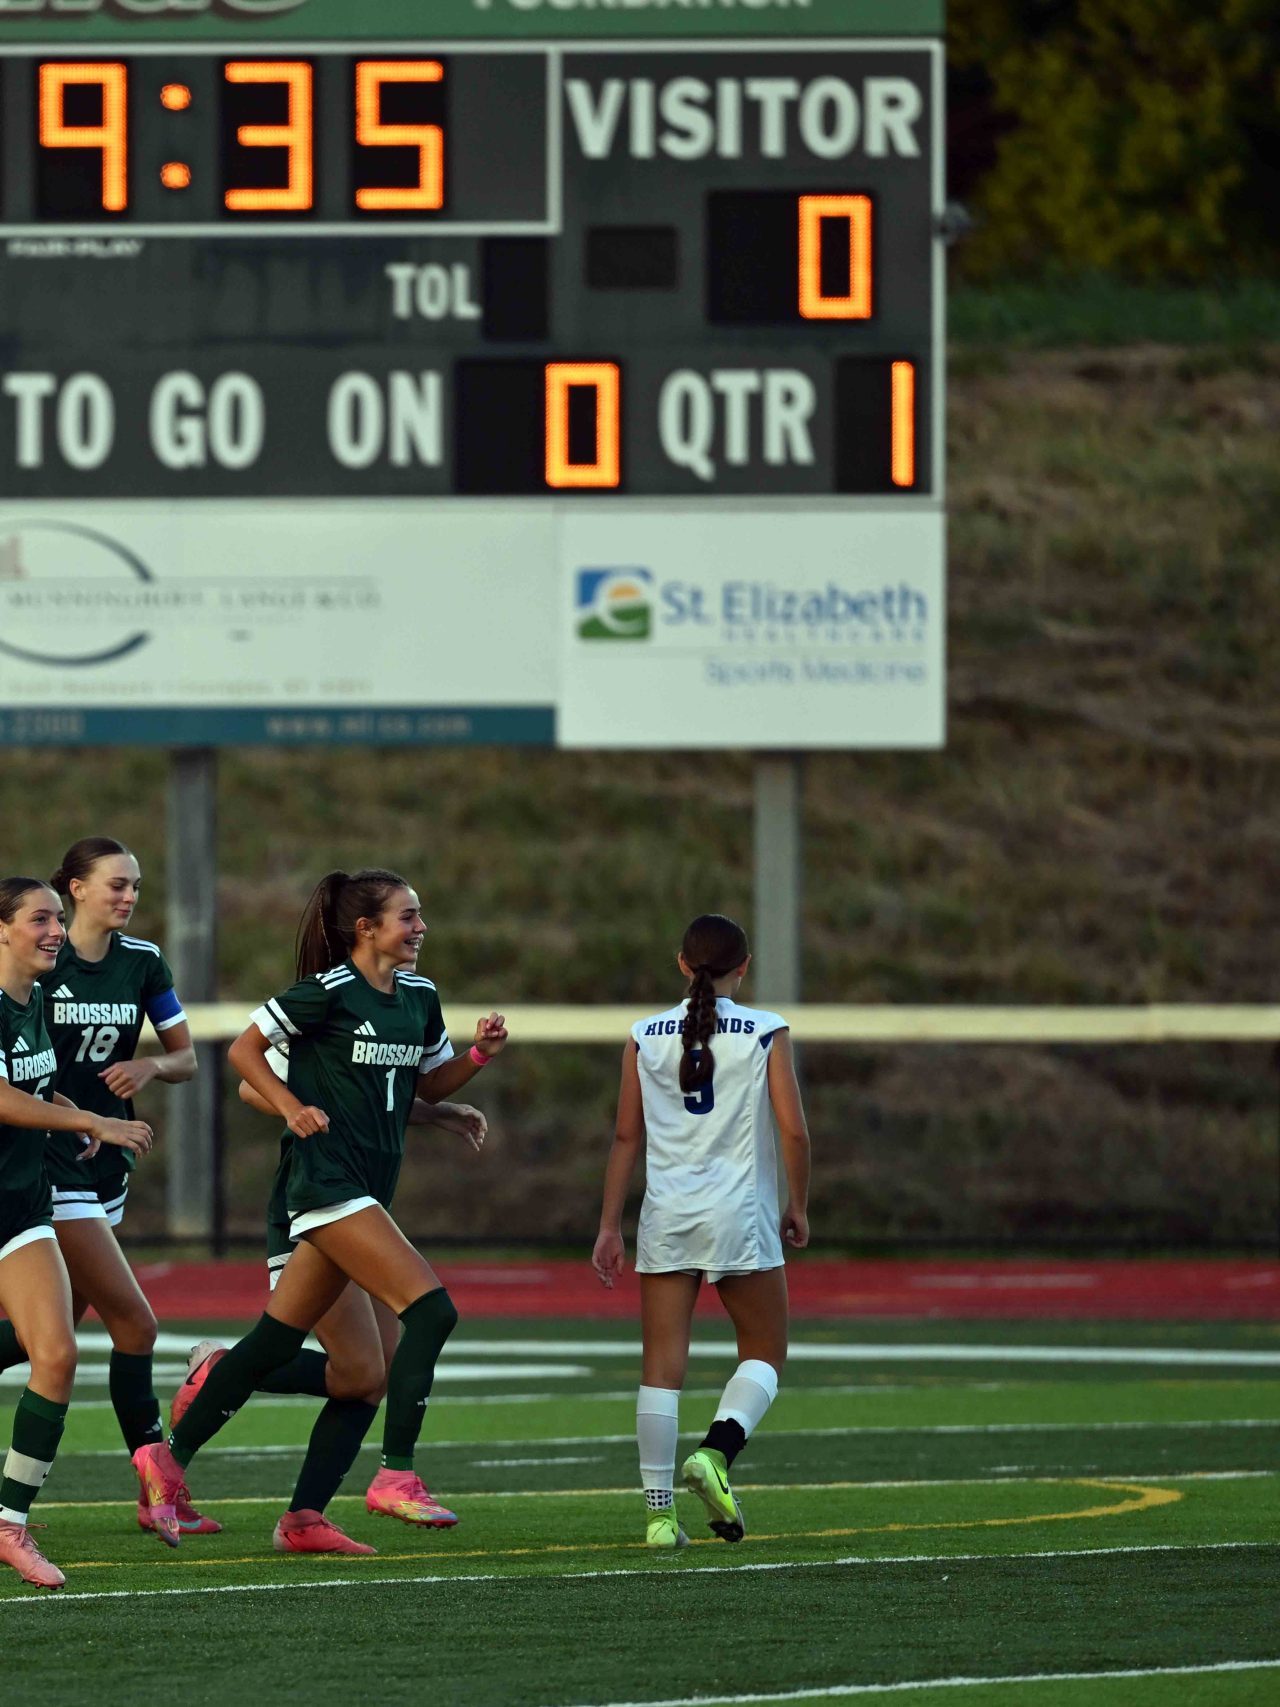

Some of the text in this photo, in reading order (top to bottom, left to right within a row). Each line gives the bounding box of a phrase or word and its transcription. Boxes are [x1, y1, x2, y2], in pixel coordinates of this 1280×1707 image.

[567, 76, 921, 159] VISITOR
[798, 194, 872, 319] 0
[385, 262, 482, 320] TOL
[3, 370, 444, 469] TO GO ON
[544, 362, 620, 487] 0
[658, 369, 817, 481] QTR
[890, 360, 915, 487] 1
[721, 578, 928, 628] Elizabeth
[54, 1002, 138, 1025] BROSSART
[644, 1017, 756, 1036] HIGNDS
[11, 1047, 58, 1082] BROSSA
[75, 1025, 120, 1062] 18
[351, 1040, 424, 1067] BROSSAR
[385, 1067, 397, 1112] 1
